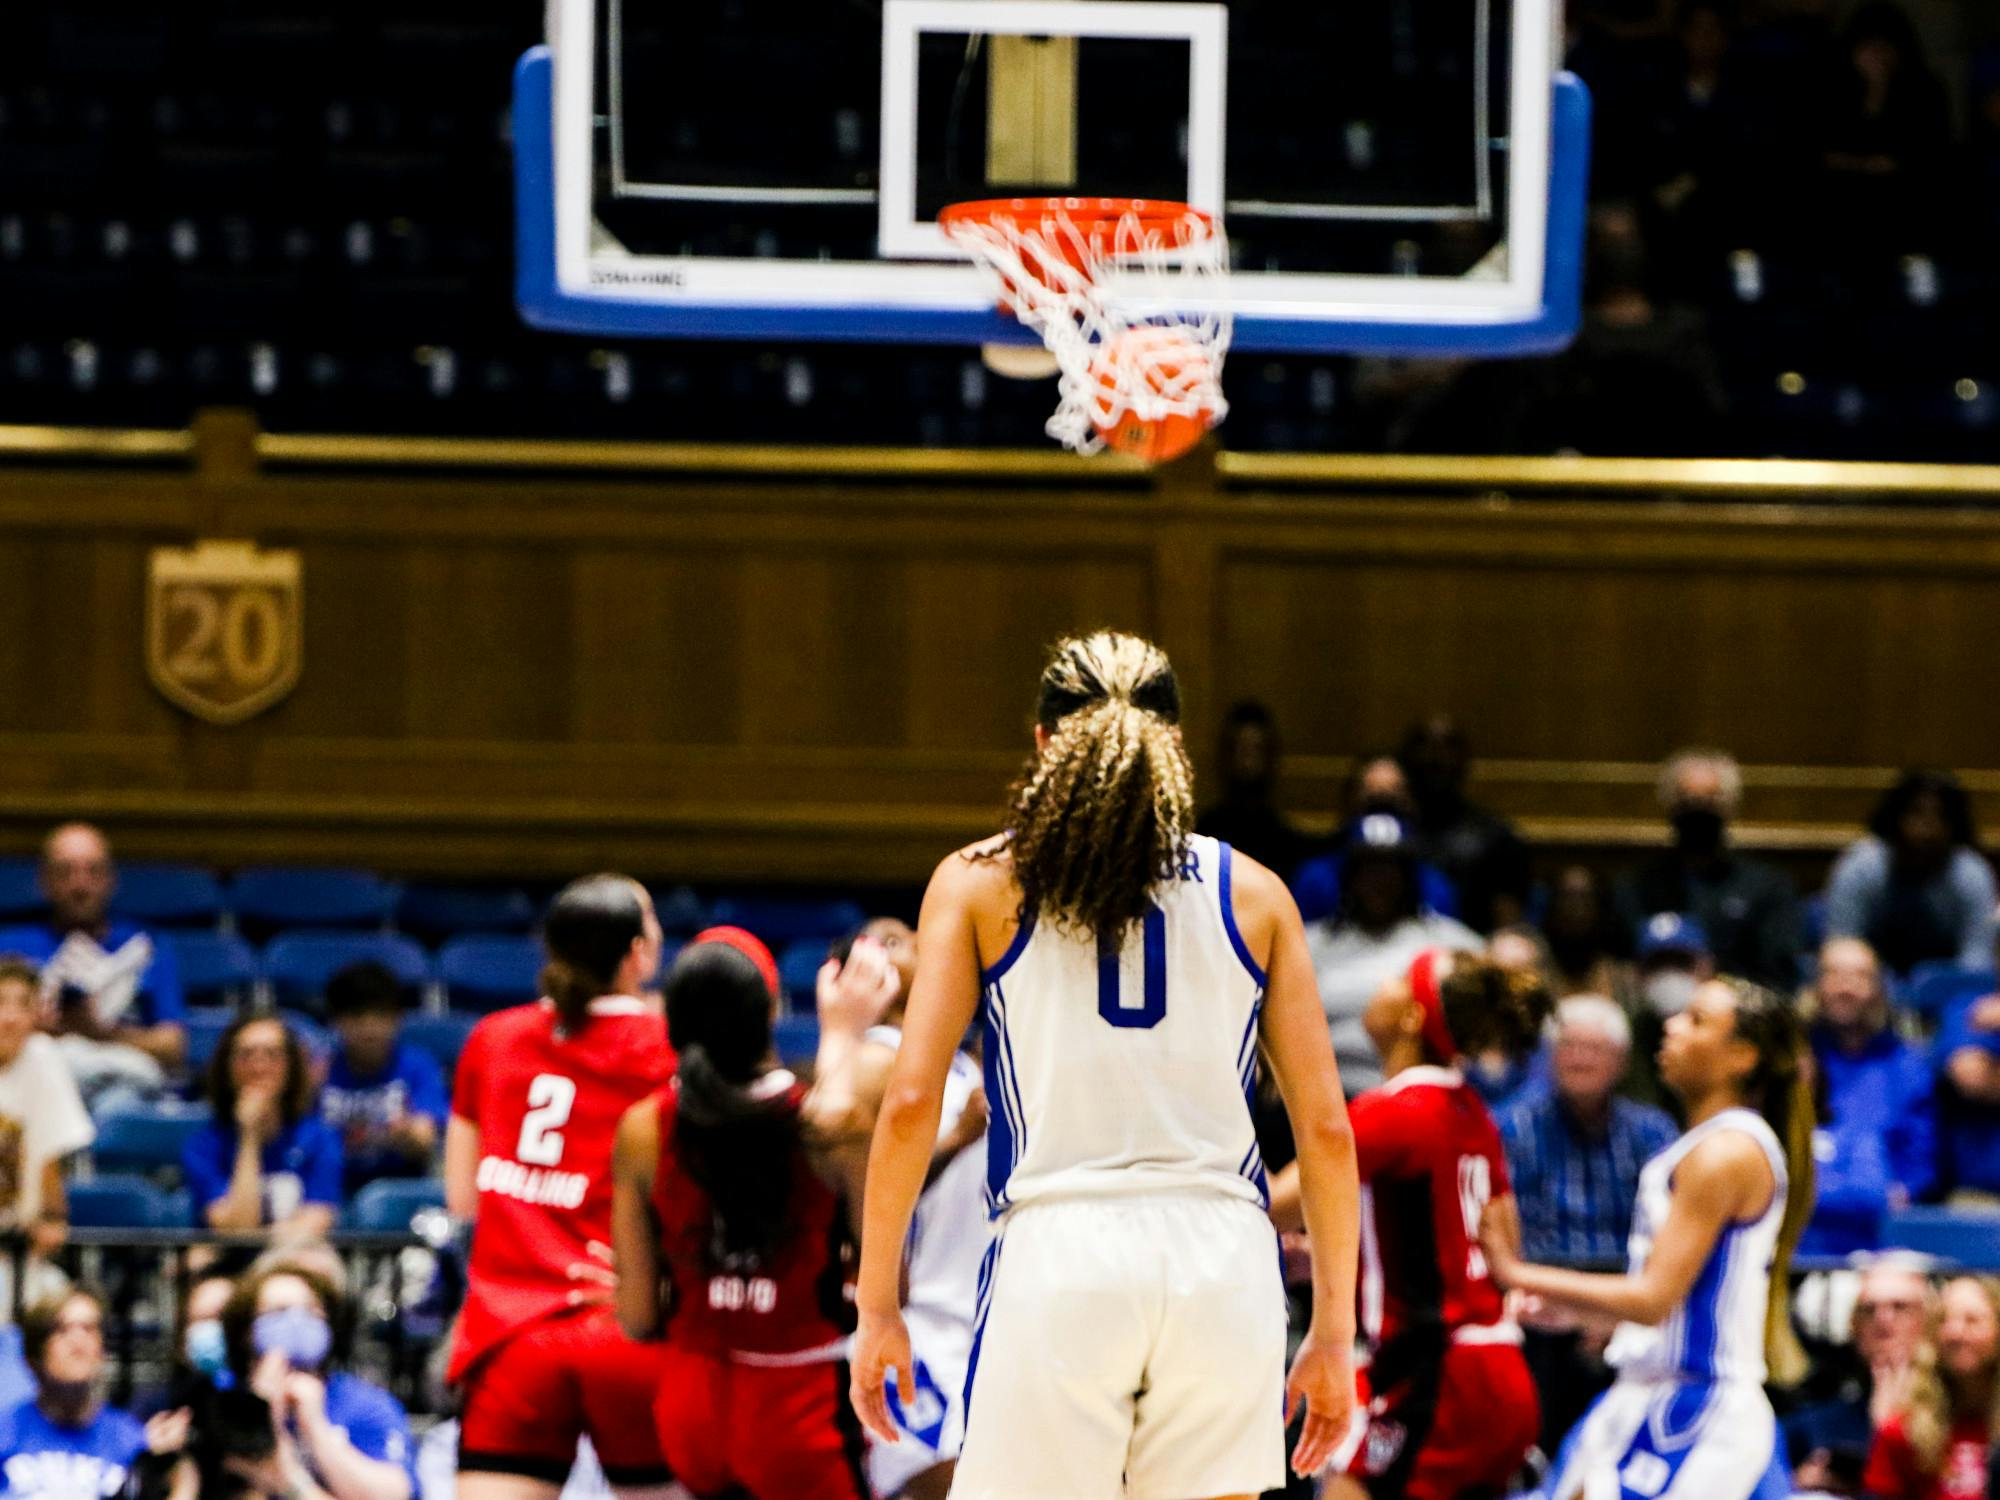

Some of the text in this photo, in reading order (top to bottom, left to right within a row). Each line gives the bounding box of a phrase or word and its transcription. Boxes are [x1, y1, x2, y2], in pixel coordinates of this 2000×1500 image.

[168, 588, 283, 689] 20
[1097, 902, 1167, 1028] 0
[517, 1072, 577, 1167] 2
